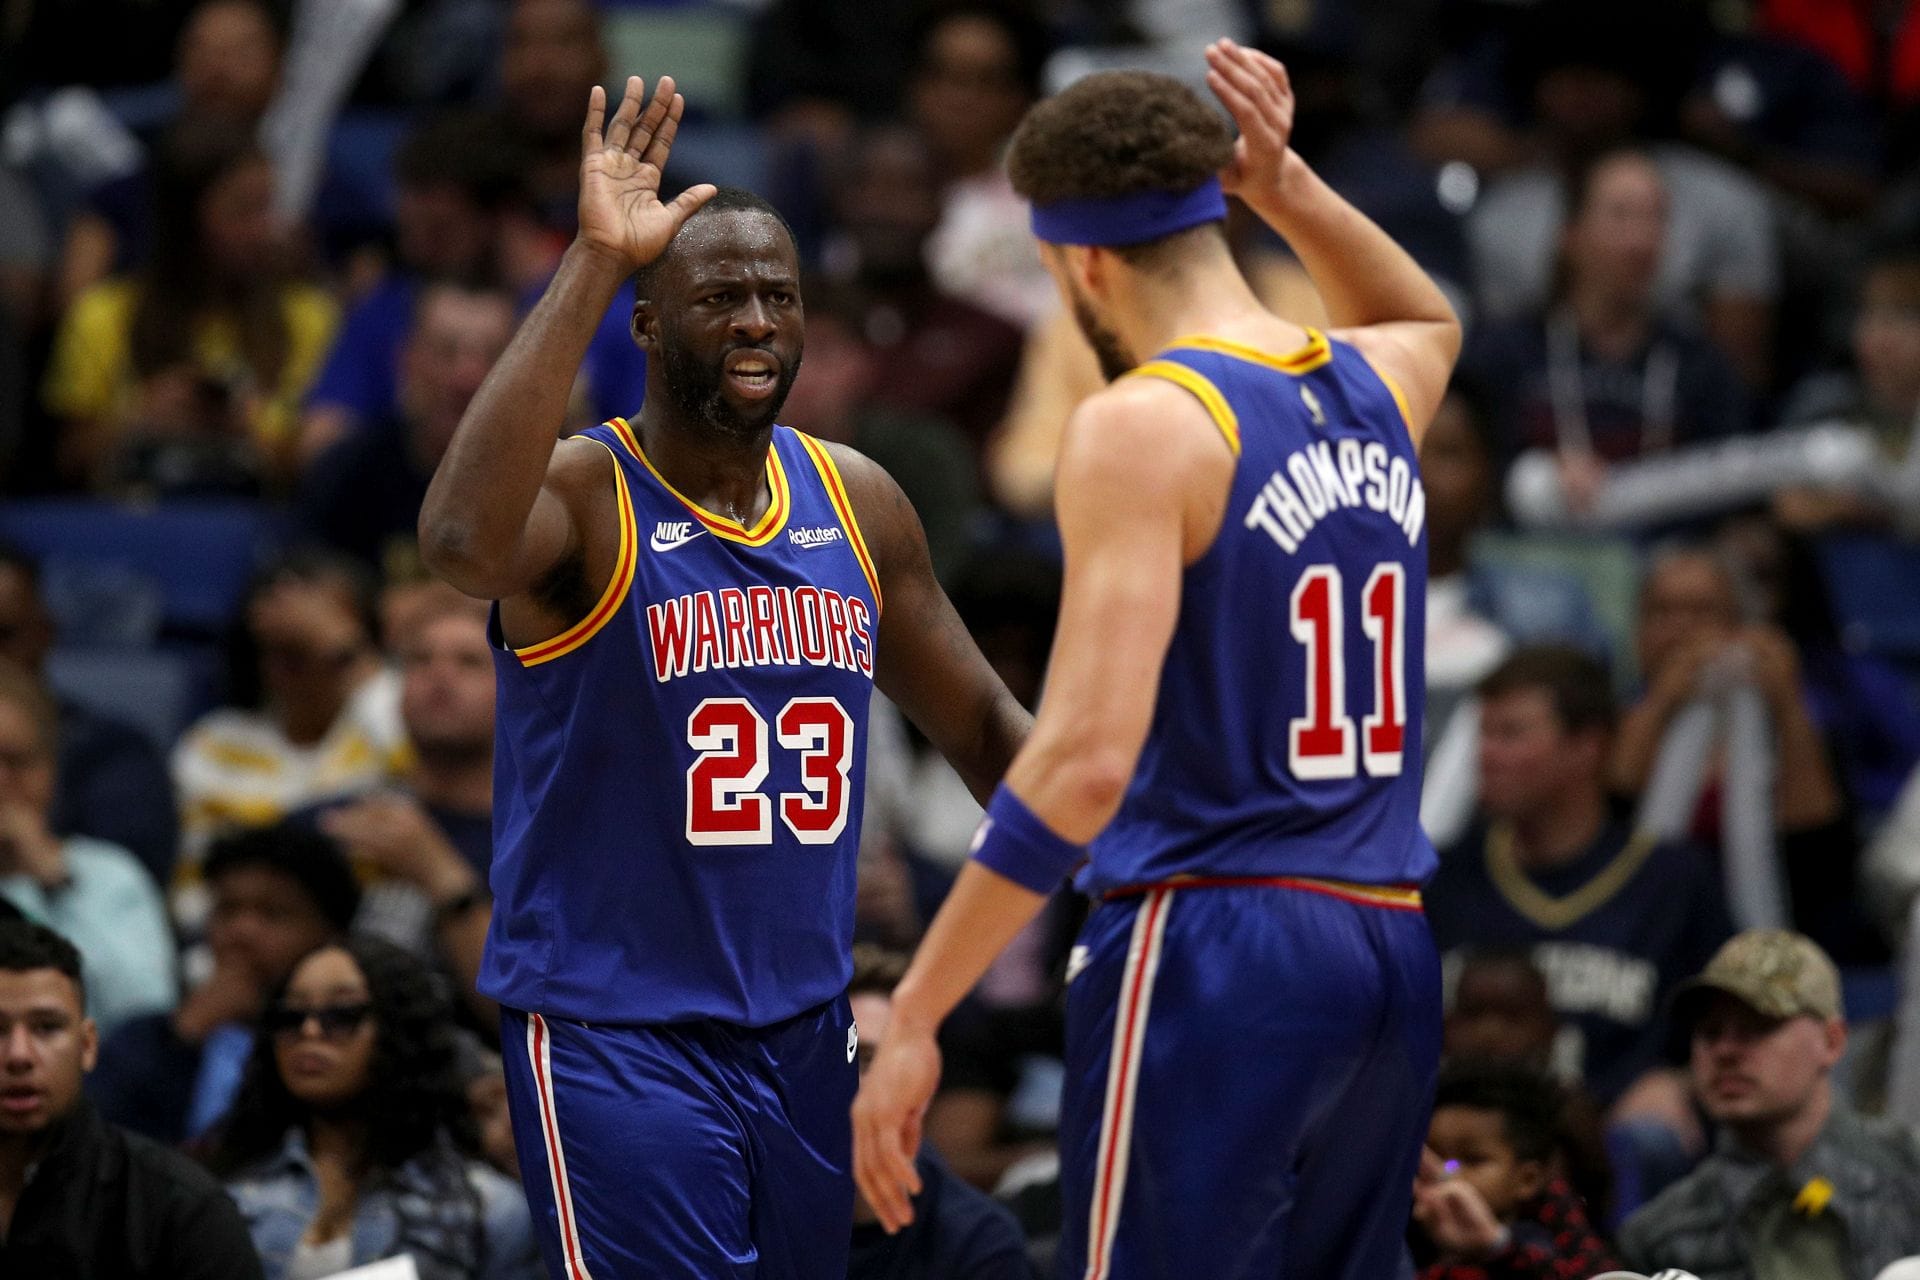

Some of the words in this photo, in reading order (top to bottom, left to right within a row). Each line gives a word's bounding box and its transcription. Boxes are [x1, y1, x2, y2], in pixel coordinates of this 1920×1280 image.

[656, 522, 692, 541] NIKE
[788, 526, 843, 546] Rakuten
[1244, 438, 1425, 555] THOMPSON
[646, 585, 873, 683] WARRIORS
[1289, 561, 1406, 781] 11
[686, 697, 854, 846] 23
